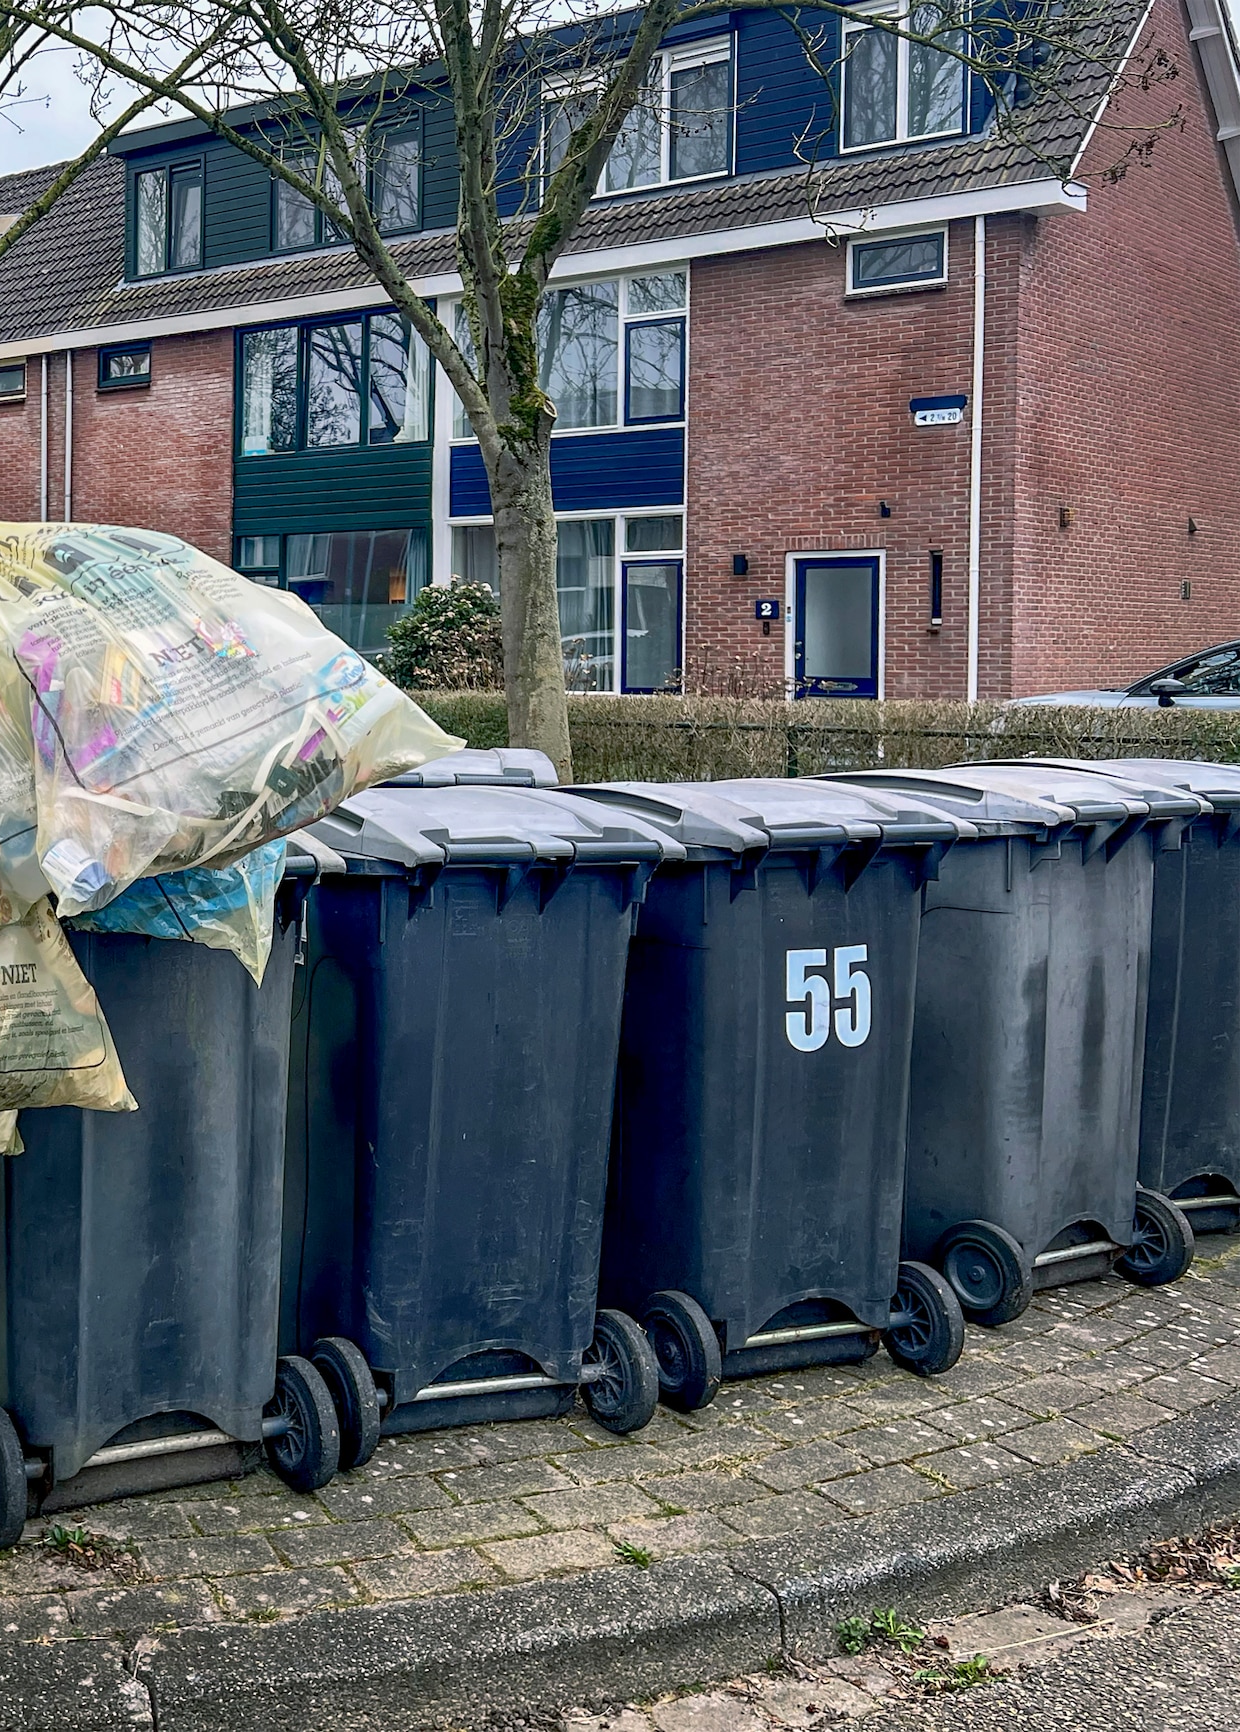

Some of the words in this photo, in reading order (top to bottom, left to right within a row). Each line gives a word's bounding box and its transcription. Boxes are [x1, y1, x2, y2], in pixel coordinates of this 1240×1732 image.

[930, 413, 935, 422] 2
[947, 411, 957, 421] 20
[760, 602, 772, 616] 2
[148, 635, 205, 668] NET
[226, 712, 241, 722] van
[0, 963, 37, 986] NIET
[785, 944, 872, 1052] 55
